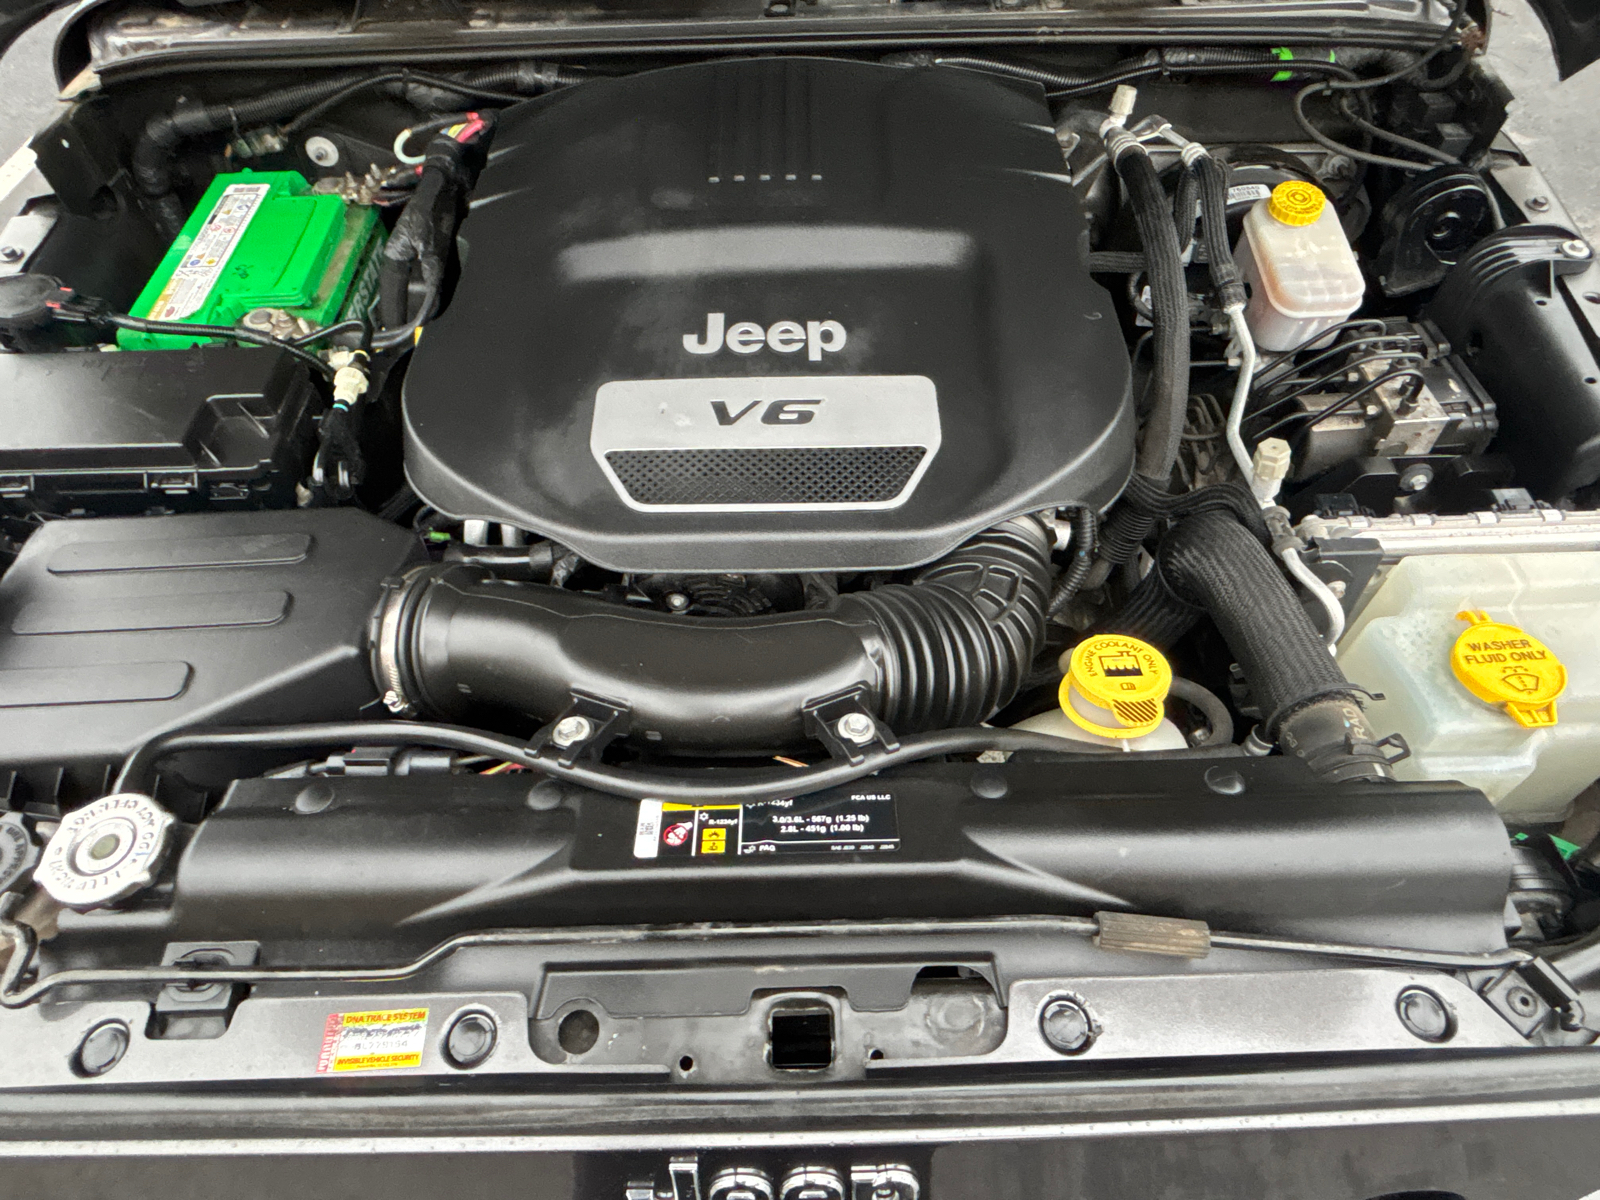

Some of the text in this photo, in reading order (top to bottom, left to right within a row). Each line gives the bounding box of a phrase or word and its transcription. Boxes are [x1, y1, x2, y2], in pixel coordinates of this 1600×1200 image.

[682, 312, 847, 362] Jeep
[710, 399, 826, 426] V6
[1466, 639, 1532, 652] WASHER
[1085, 640, 1158, 678] ENGINE COOLANT ONLY
[1464, 650, 1547, 664] FLUID ONLY
[1342, 707, 1368, 739] RAD
[857, 814, 870, 823] lb)
[852, 824, 864, 832] lb)
[346, 1011, 426, 1024] DNA TRACE SYSTEM
[337, 1053, 419, 1065] INVISIBLE VEHICLE SECURITY
